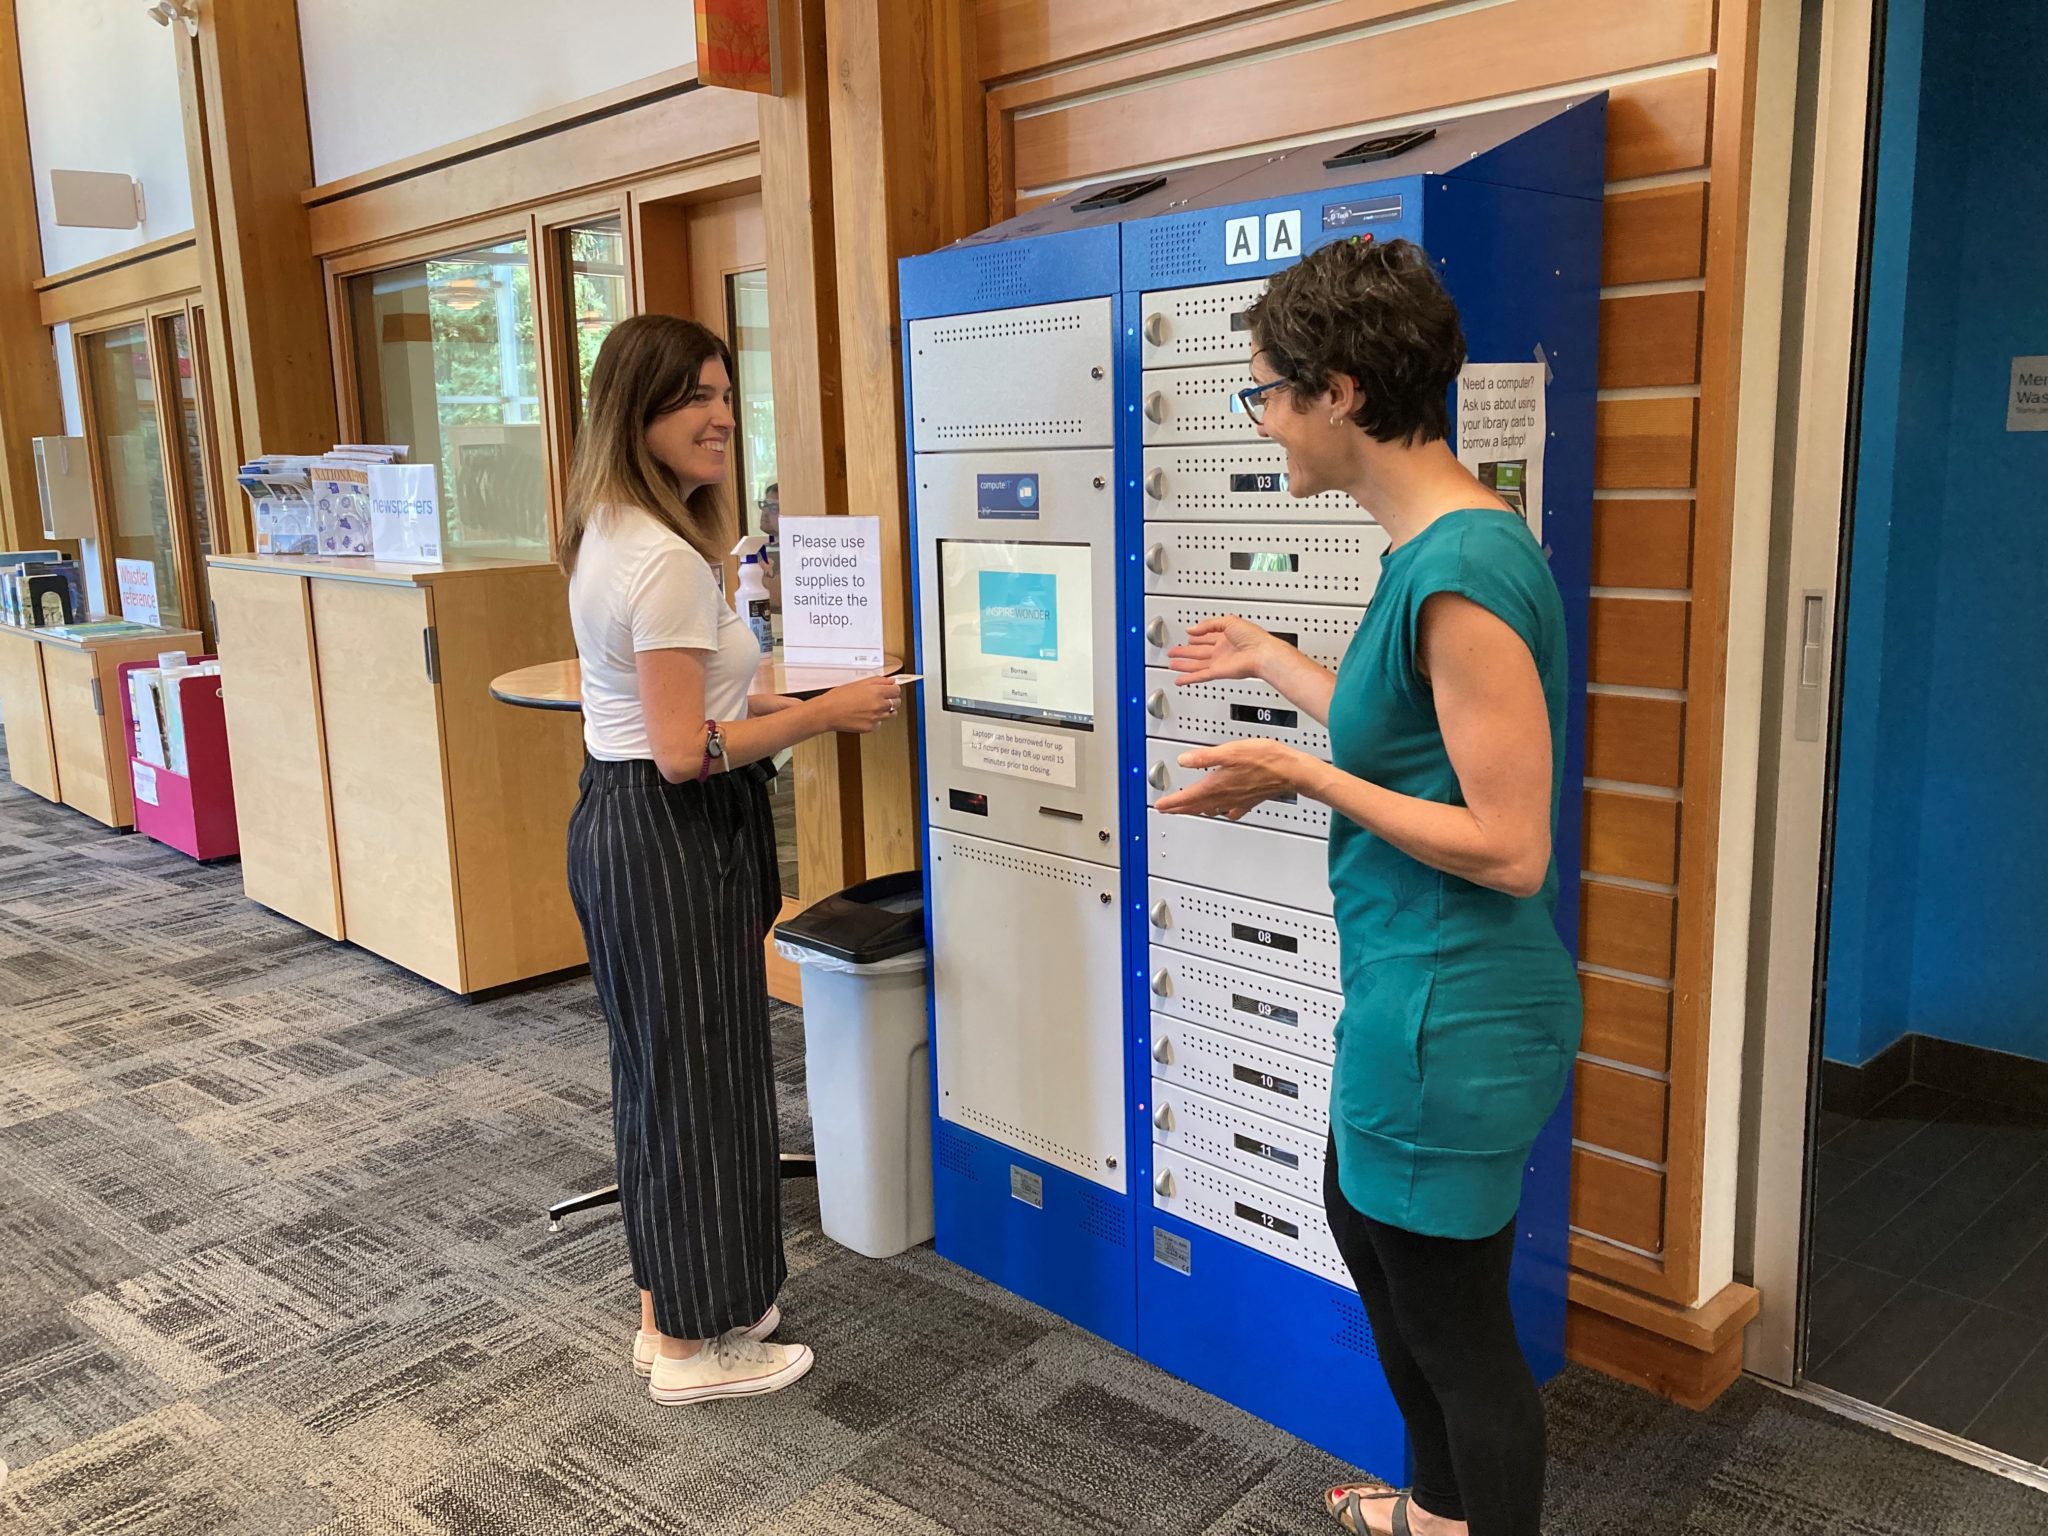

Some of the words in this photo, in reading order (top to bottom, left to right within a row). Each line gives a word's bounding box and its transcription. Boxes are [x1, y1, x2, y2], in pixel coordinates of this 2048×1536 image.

[1232, 225, 1251, 258] A
[1273, 219, 1292, 253] A
[1462, 377, 1485, 390] Need
[1488, 380, 1494, 390] a
[1496, 376, 1535, 391] computer?
[1462, 398, 1479, 411] Ask
[1481, 400, 1491, 411] us
[1494, 397, 1517, 410] about
[1518, 399, 1536, 411] using
[1462, 420, 1480, 433] your
[1482, 416, 1509, 431] library
[1510, 416, 1526, 428] card
[1527, 416, 1535, 427] to
[1462, 437, 1491, 449] borrow
[1493, 437, 1499, 447] a
[1501, 434, 1526, 448] laptop!
[1257, 475, 1272, 489] 03
[372, 498, 433, 517] newspaers
[792, 534, 837, 548] Please
[841, 537, 865, 548] use
[801, 554, 857, 570] provided
[119, 566, 149, 586] Whistler
[795, 574, 849, 589] supplies
[853, 574, 865, 588] to
[122, 587, 157, 609] reference
[794, 593, 843, 606] sanitize
[847, 593, 868, 607] the
[809, 612, 853, 628] laptop.
[1010, 666, 1028, 675] Borrow
[1011, 689, 1028, 697] Return
[1257, 708, 1271, 721] 06
[995, 733, 1005, 742] can
[1005, 733, 1014, 743] be
[1014, 736, 1044, 748] borrowed
[1044, 740, 1054, 749] for
[1054, 743, 1063, 751] up
[971, 742, 978, 750] to
[1000, 745, 1010, 754] per
[1011, 748, 1021, 758] day
[1022, 749, 1032, 758] OR
[1033, 753, 1041, 761] up
[1041, 753, 1056, 763] until
[1056, 755, 1065, 764] 15
[983, 756, 1006, 767] minutes
[1006, 760, 1021, 770] prior
[1022, 763, 1029, 771] to
[1257, 930, 1272, 944] 08
[1257, 1002, 1272, 1016] 09
[1260, 1074, 1274, 1088] 10
[1260, 1144, 1271, 1157] 11
[1261, 1213, 1274, 1228] 12
